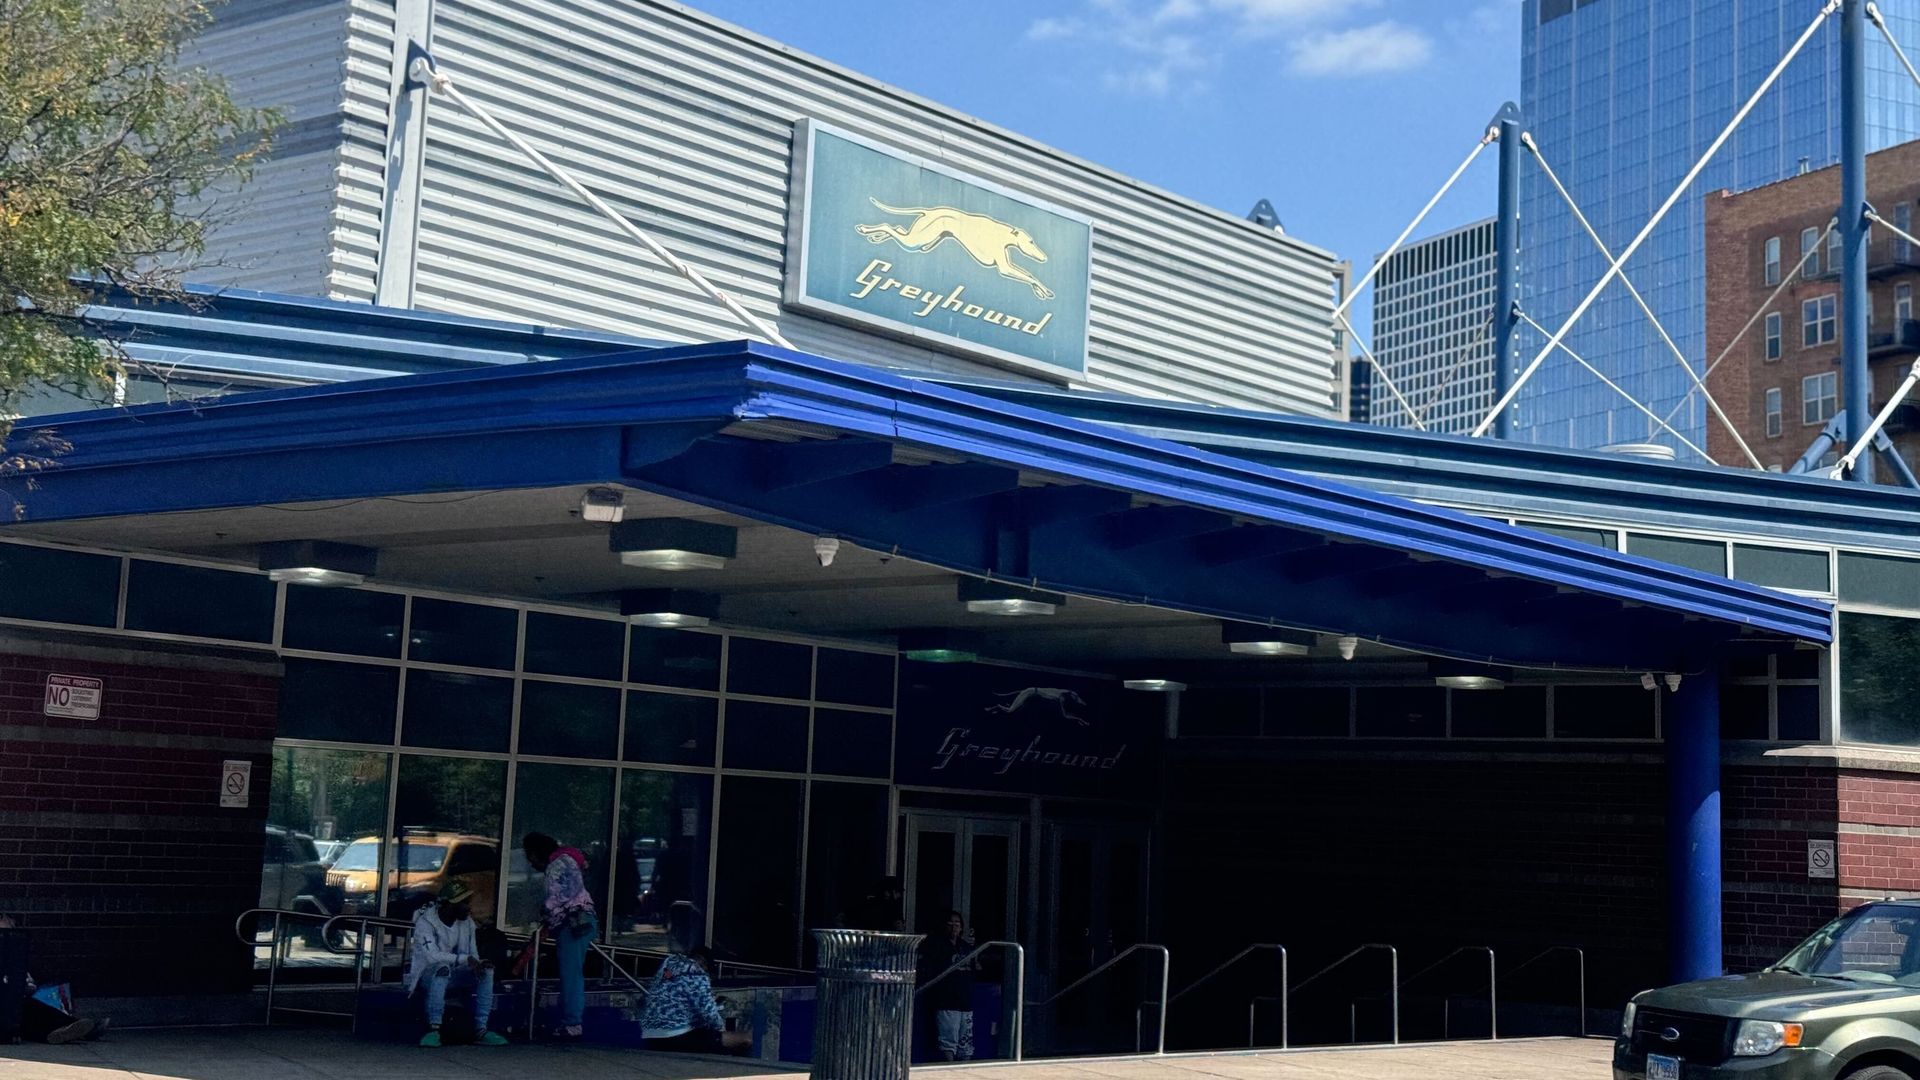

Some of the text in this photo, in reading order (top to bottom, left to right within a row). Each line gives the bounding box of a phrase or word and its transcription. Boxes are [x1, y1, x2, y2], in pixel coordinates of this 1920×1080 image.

[850, 259, 1052, 335] Greyhound
[48, 687, 70, 705] NO
[931, 728, 1127, 775] Greyhound
